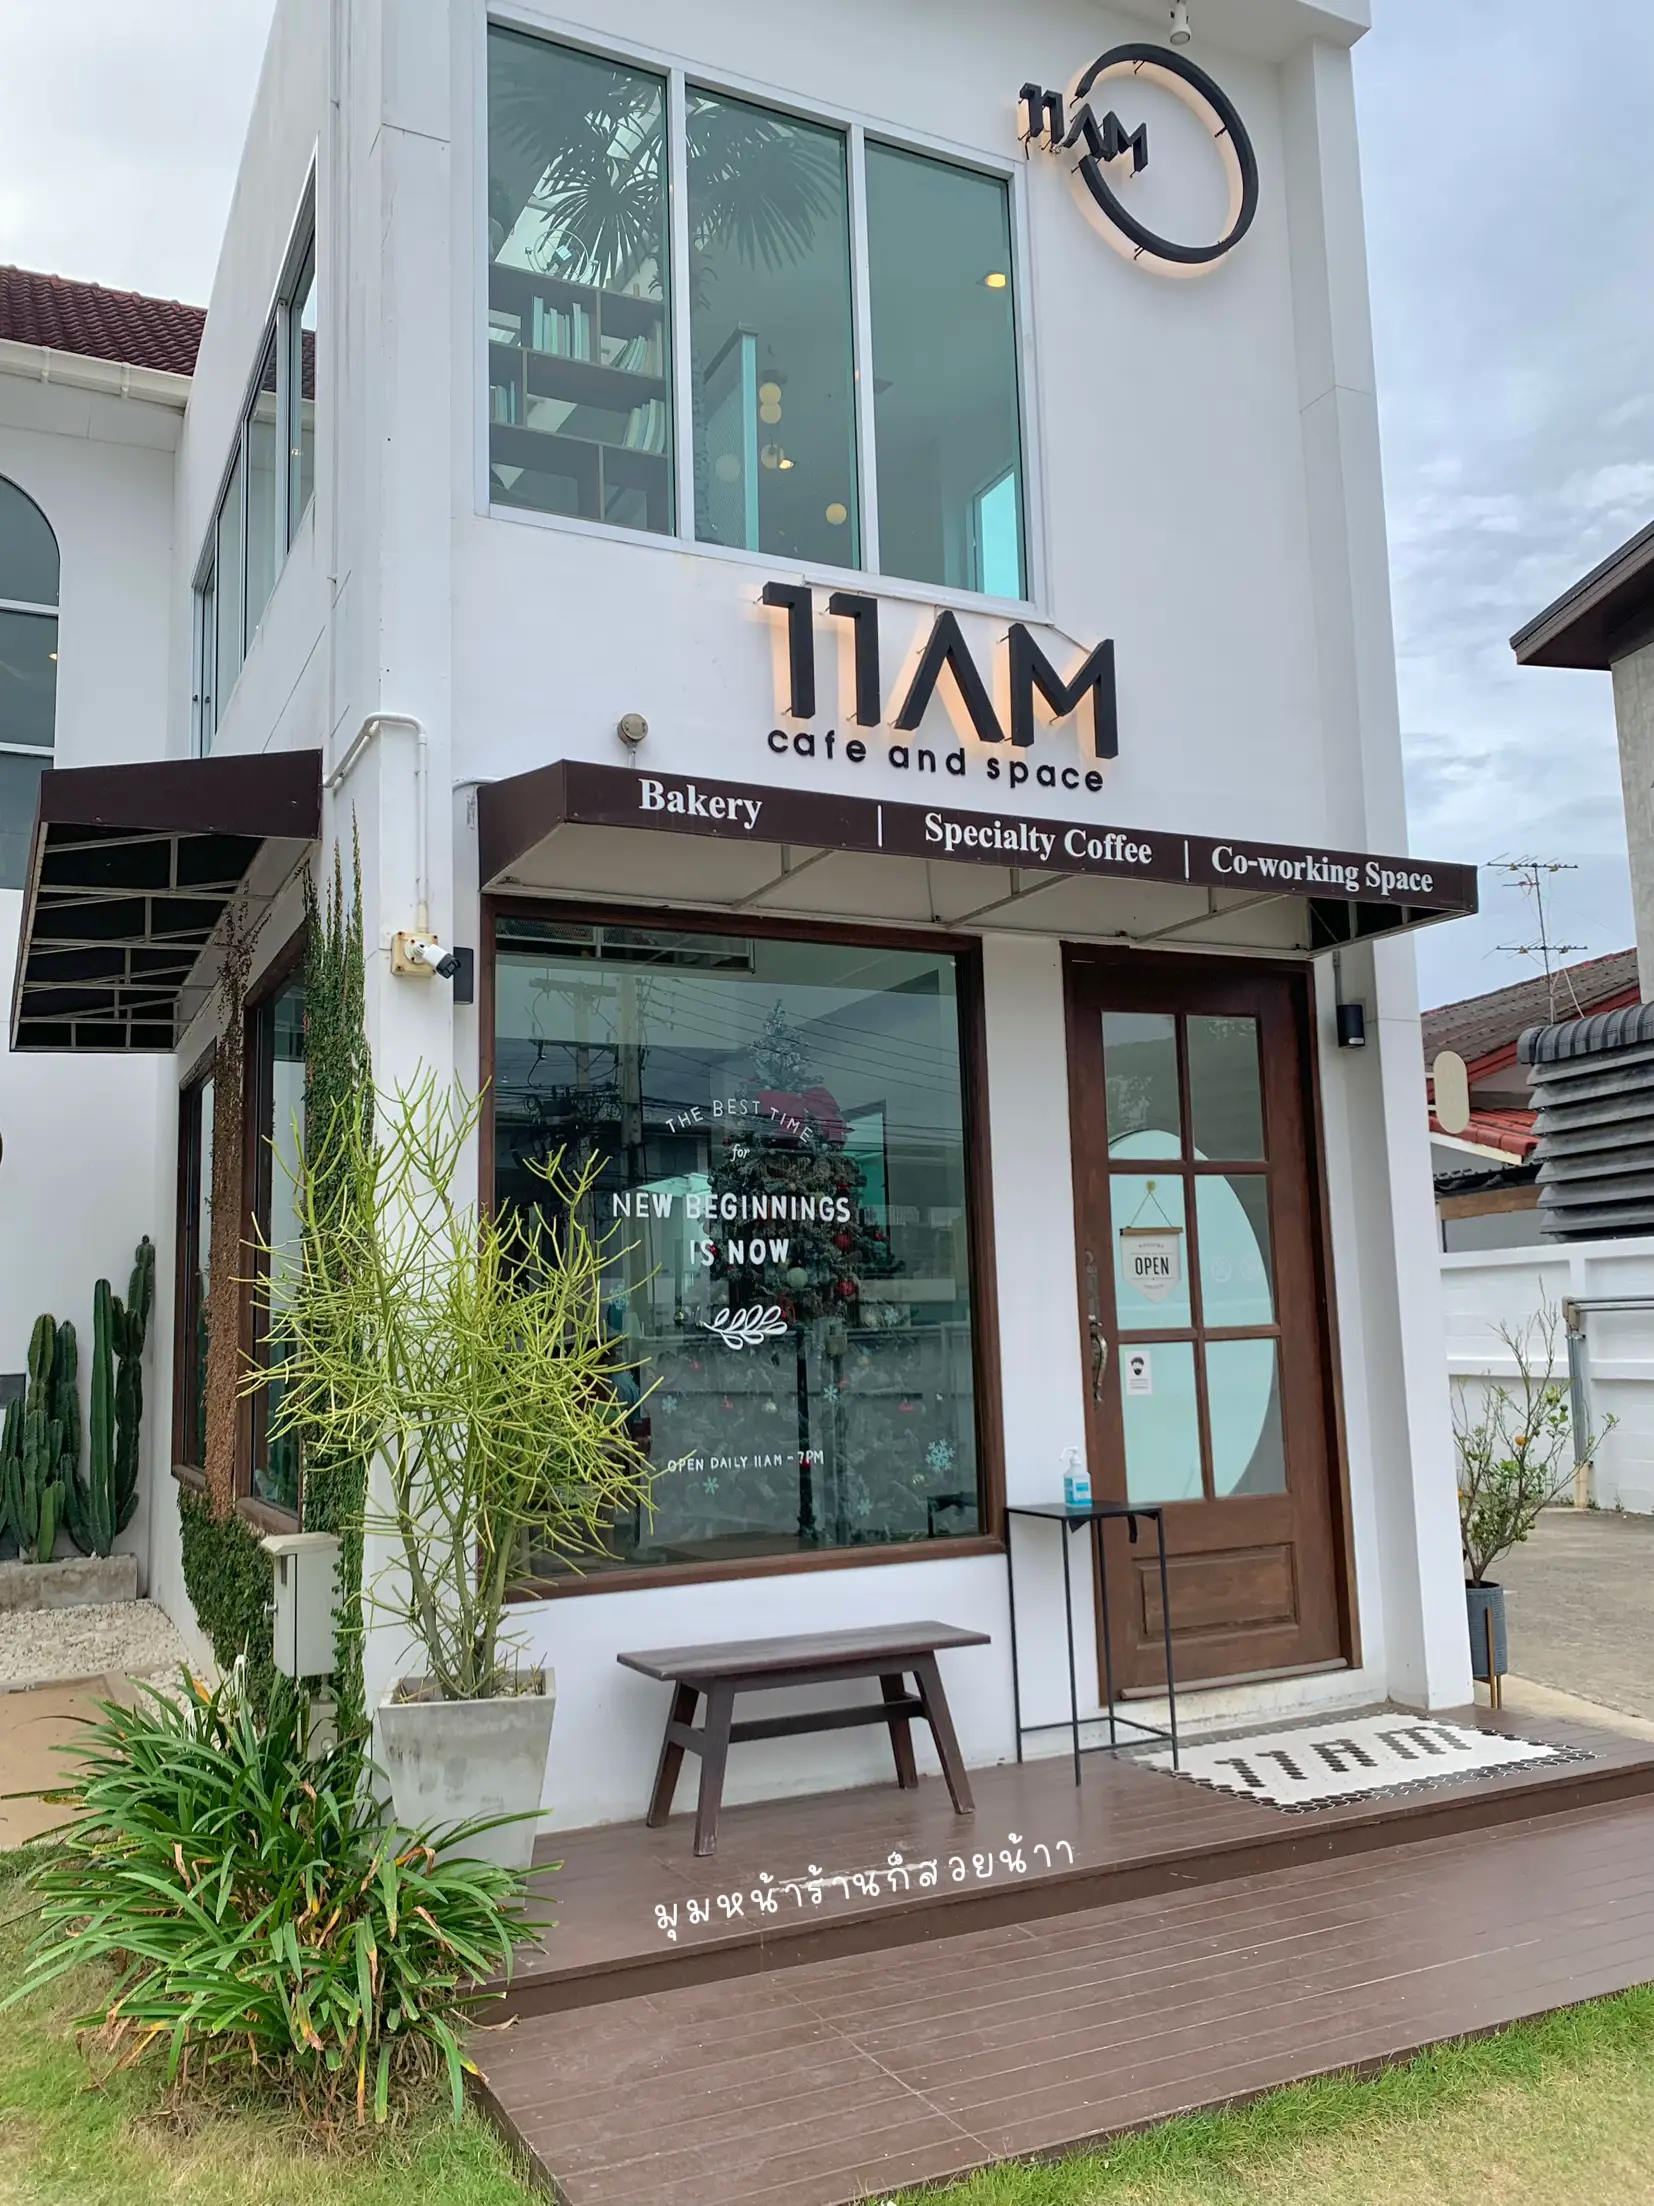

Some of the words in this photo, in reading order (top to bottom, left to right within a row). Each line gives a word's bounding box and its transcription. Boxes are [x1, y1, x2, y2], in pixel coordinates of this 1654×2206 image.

[1019, 82, 1148, 172] 11AM
[762, 581, 1119, 760] 11AM
[767, 729, 867, 763] cafe
[888, 744, 966, 776] and
[986, 756, 1104, 792] space
[638, 778, 763, 830] Bakery
[924, 812, 1056, 861] Specialty
[1063, 829, 1153, 866] Coffee
[1211, 845, 1360, 892] Co-working
[1364, 860, 1434, 896] Space
[665, 1106, 704, 1134] THE
[713, 1098, 760, 1117] BEST
[770, 1106, 813, 1143] TIME
[730, 1143, 750, 1162] for
[612, 1193, 673, 1219] NEW
[686, 1192, 851, 1223] BEGINNINGS
[690, 1239, 714, 1267] IS
[728, 1238, 790, 1265] NOW
[1135, 1256, 1169, 1275] OPEN
[667, 1458, 704, 1473] OPEN
[710, 1456, 748, 1470] DAILY
[798, 1450, 824, 1465] 7PM
